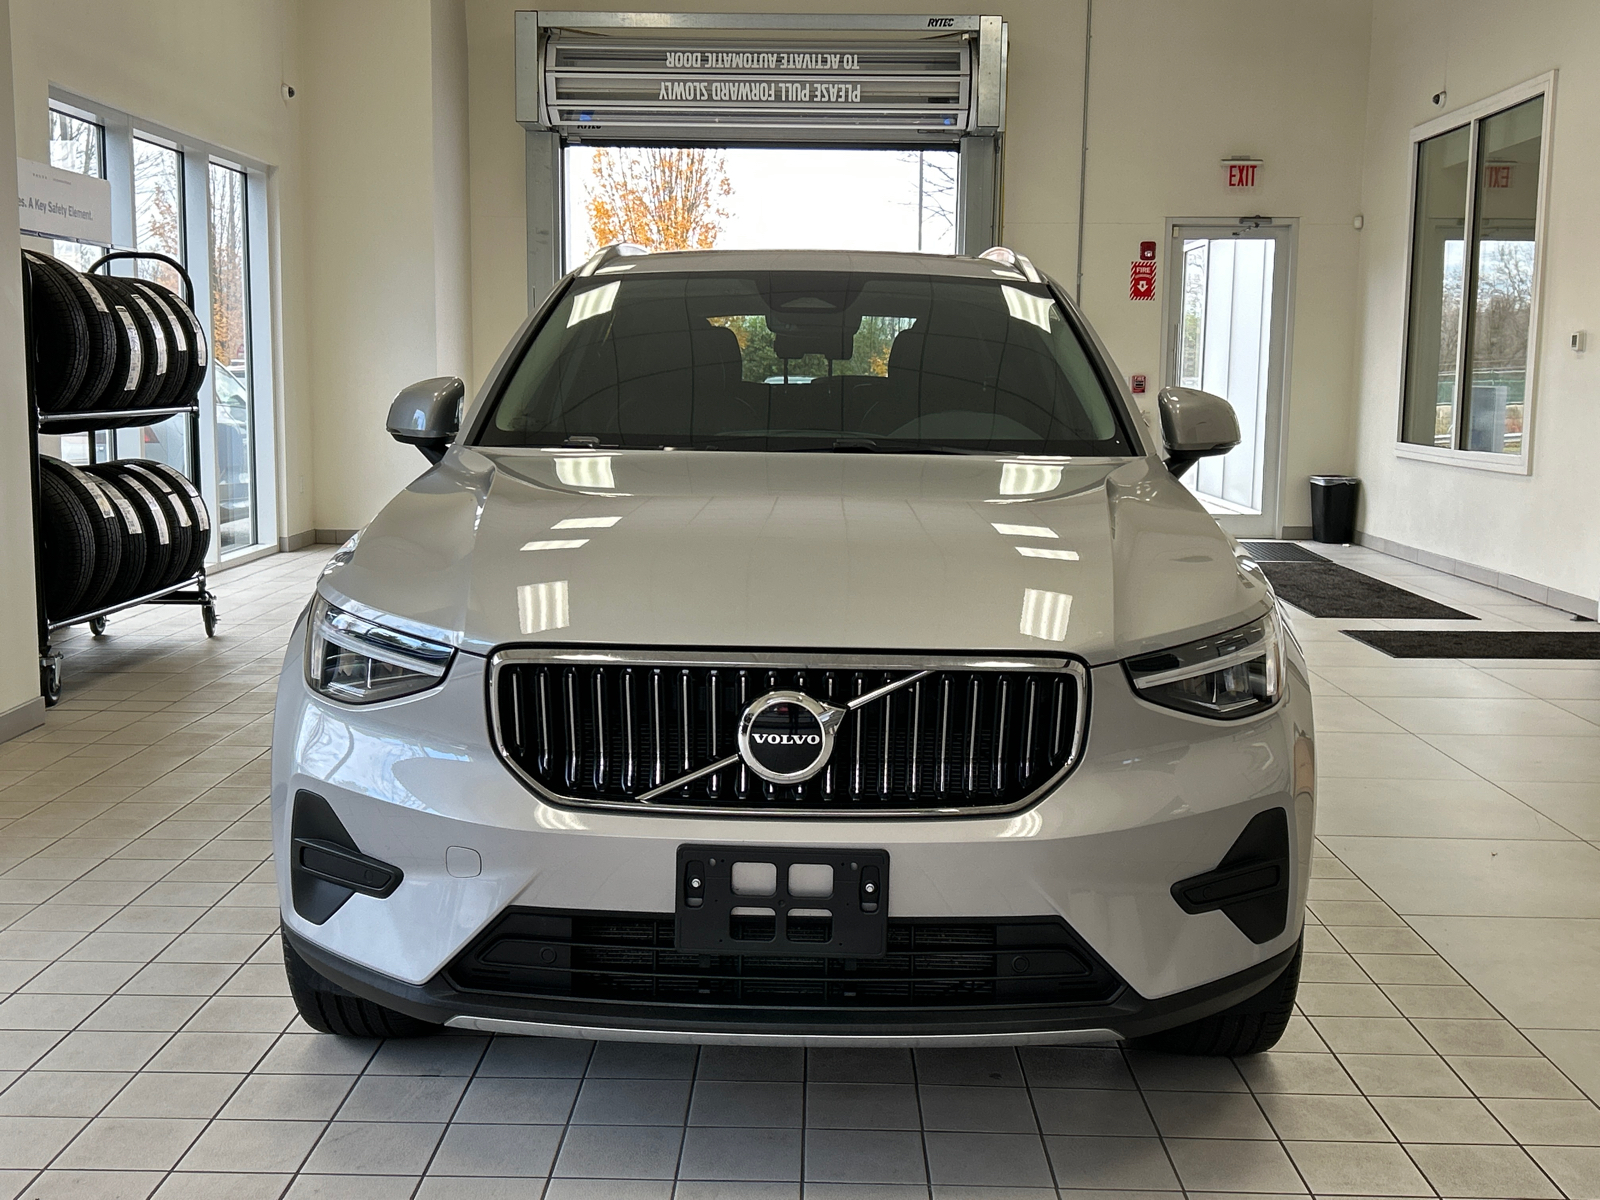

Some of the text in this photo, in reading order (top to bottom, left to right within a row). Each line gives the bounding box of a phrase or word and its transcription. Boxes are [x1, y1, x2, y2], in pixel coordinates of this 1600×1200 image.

[927, 18, 954, 27] RYTEC
[666, 52, 860, 70] TO ACTIVATE AUTOMATIC DOOR
[659, 81, 861, 102] PLEASE PULL FORWARD SLOWLY
[1228, 165, 1257, 187] EXIT
[28, 197, 34, 209] A
[34, 197, 47, 214] Key
[47, 201, 68, 218] Safety
[68, 205, 93, 221] Element.
[752, 733, 820, 745] VOLVO
